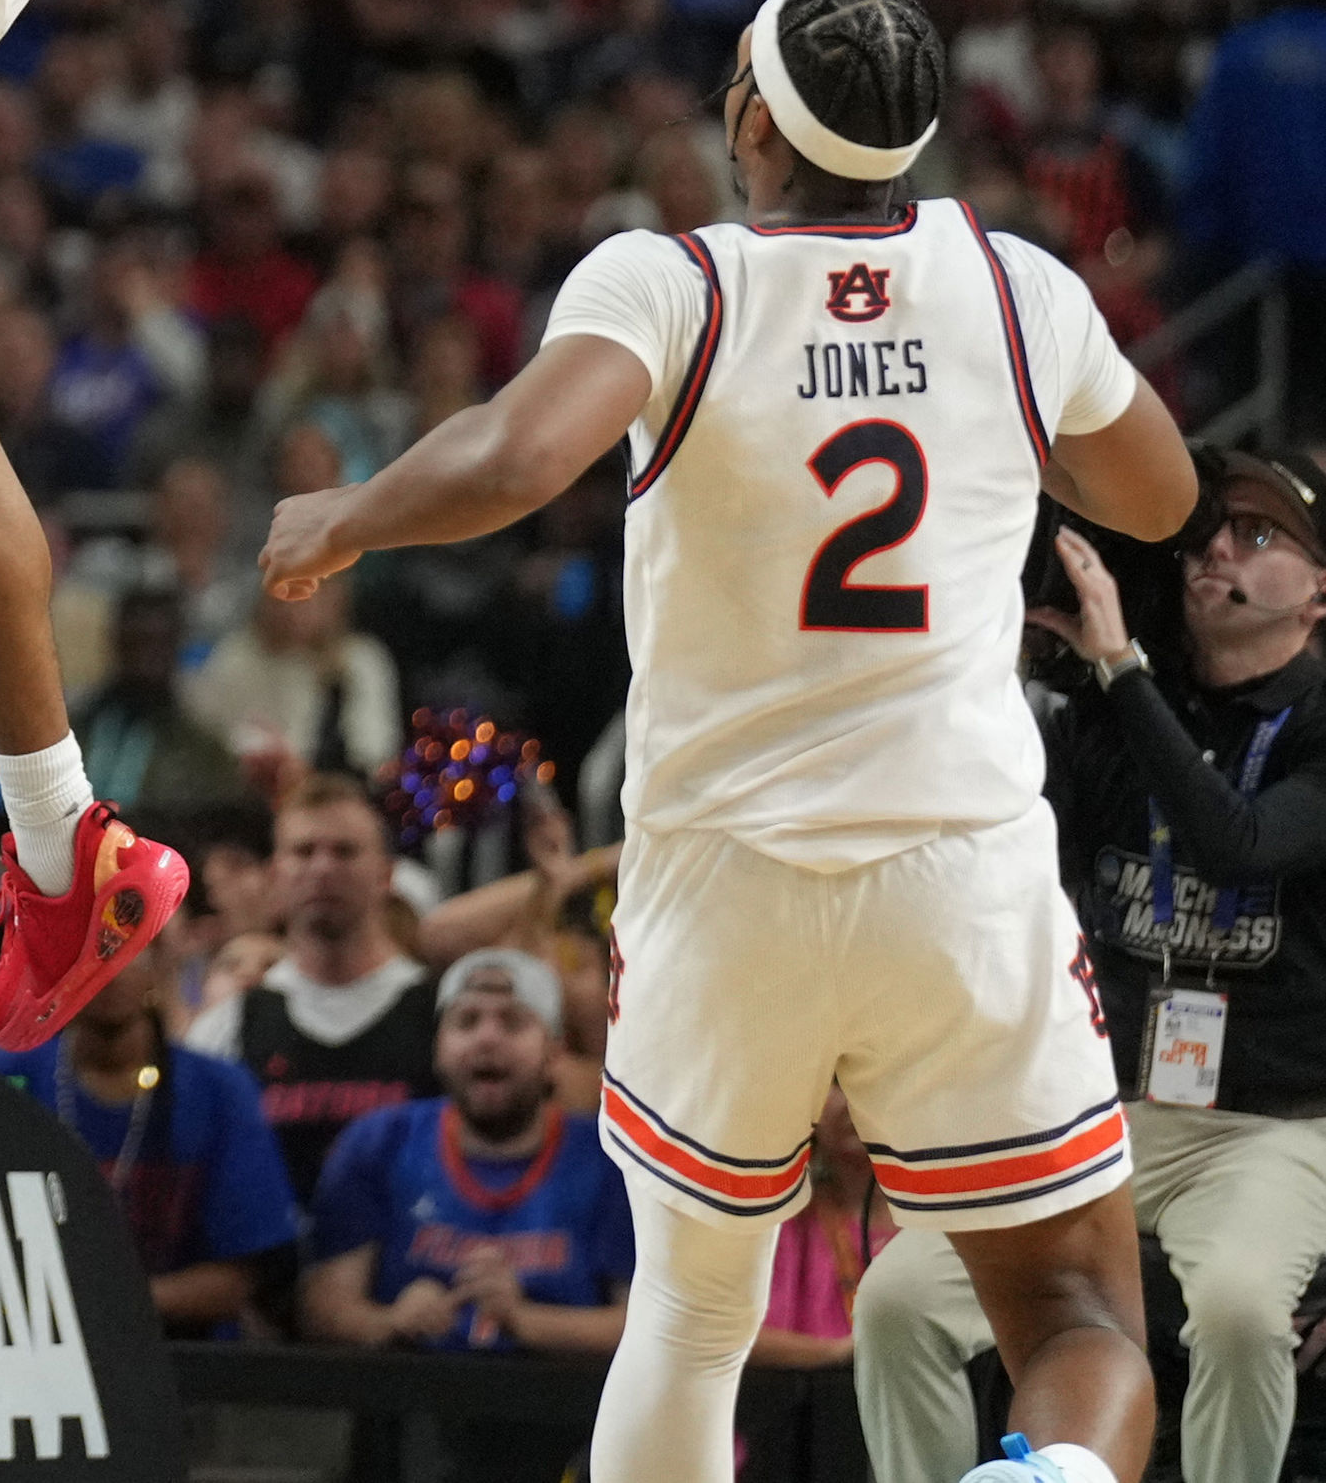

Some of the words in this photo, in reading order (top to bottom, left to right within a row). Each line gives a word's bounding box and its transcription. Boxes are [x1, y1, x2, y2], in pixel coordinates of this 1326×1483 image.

[797, 339, 927, 399] JONES
[799, 417, 929, 632] 2
[1117, 860, 1218, 914] MCH
[1122, 899, 1275, 951] MDNSS
